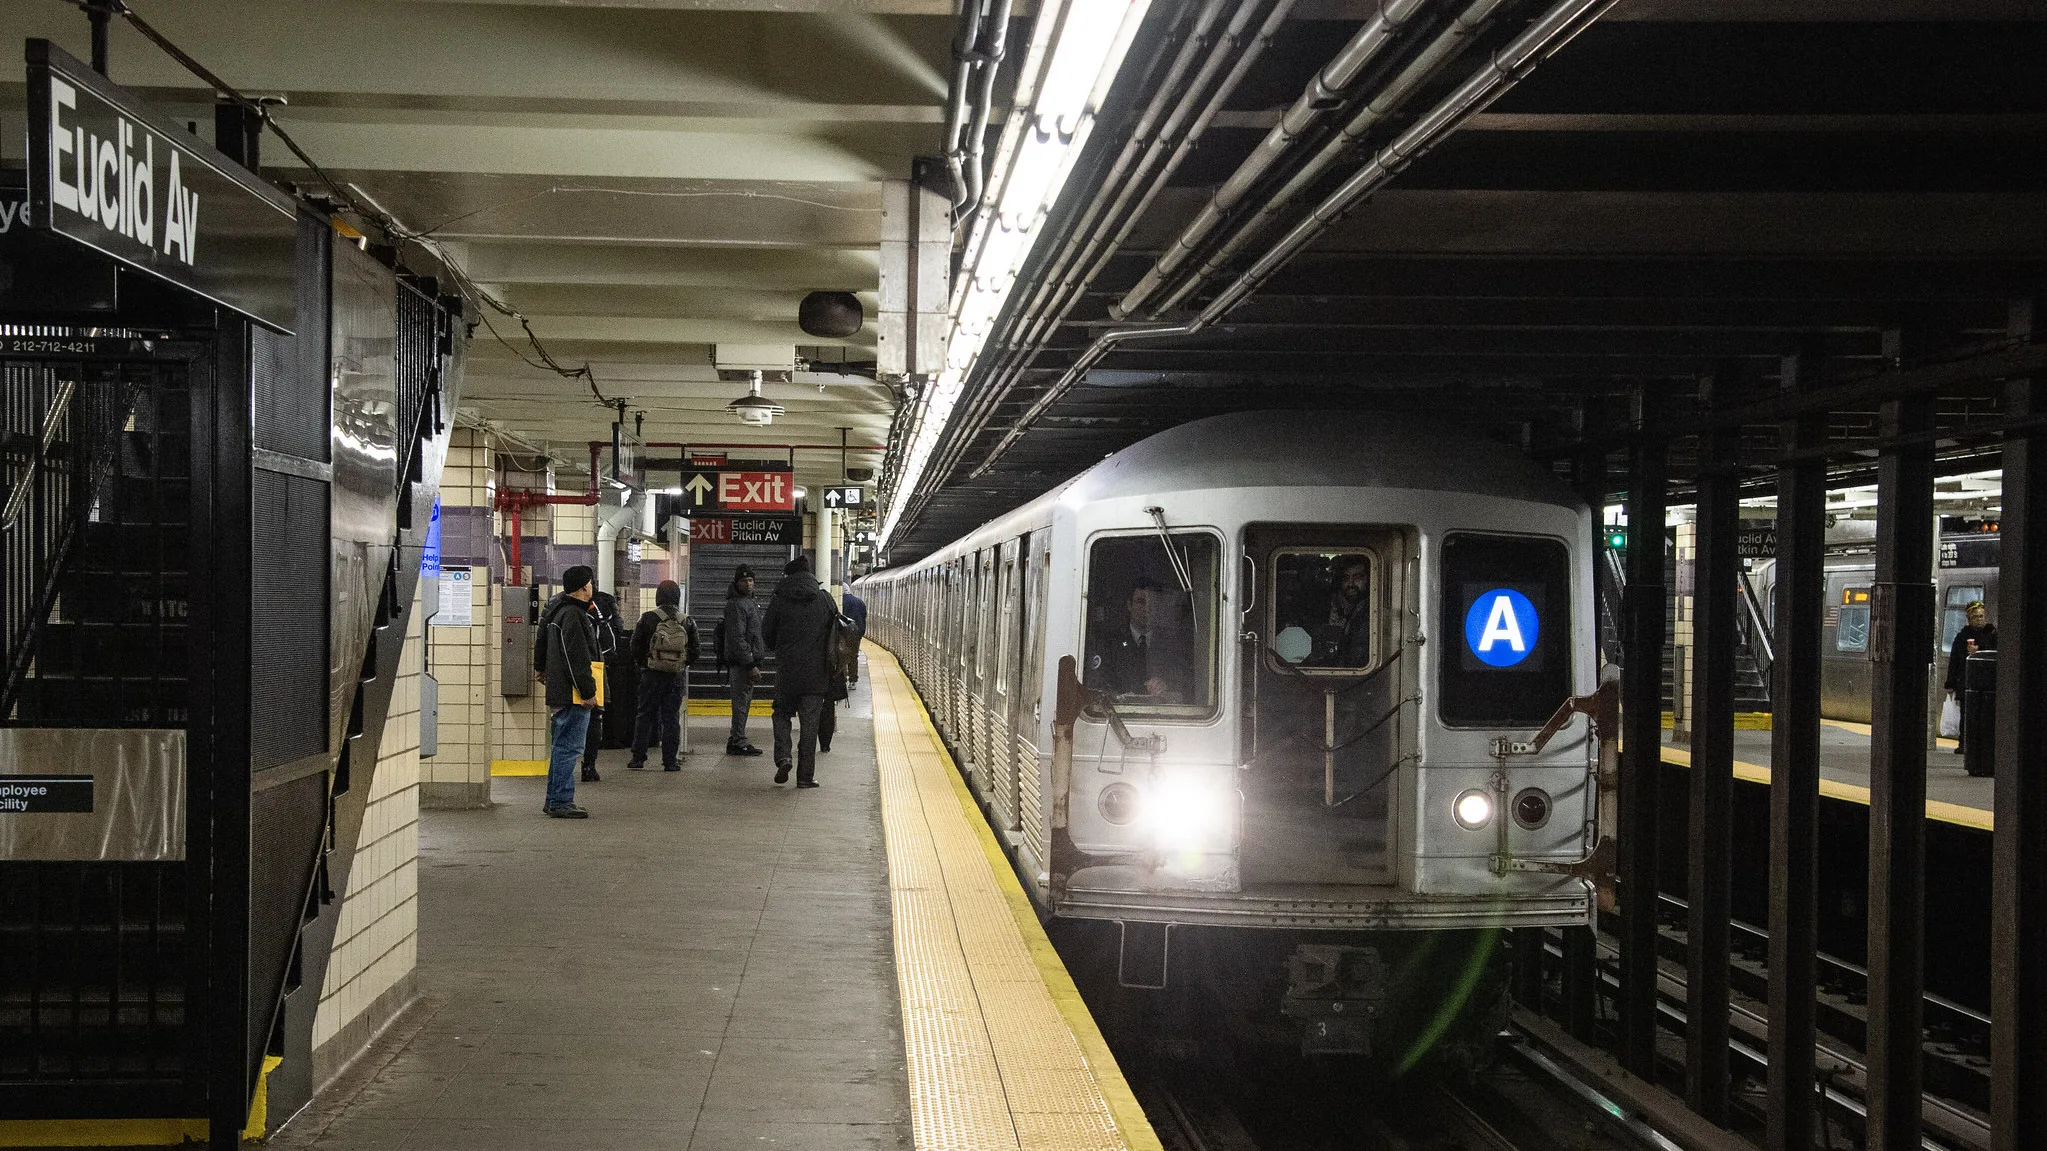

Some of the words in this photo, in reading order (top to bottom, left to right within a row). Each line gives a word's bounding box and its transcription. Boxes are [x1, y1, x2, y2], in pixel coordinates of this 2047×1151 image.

[51, 76, 153, 247] Euclid
[164, 150, 198, 266] Av
[13, 340, 95, 353] 212-712-4211
[719, 473, 785, 503] Exit
[731, 519, 765, 530] Euclid
[768, 520, 783, 531] Av
[731, 531, 762, 541] Pitkin
[764, 531, 779, 541] Av
[1738, 533, 1762, 544] uclid
[1737, 544, 1758, 555] tkin
[1761, 544, 1776, 555] Av
[422, 554, 438, 562] Help
[1478, 595, 1525, 652] A
[0, 784, 47, 797] ployee
[0, 798, 28, 811] cility
